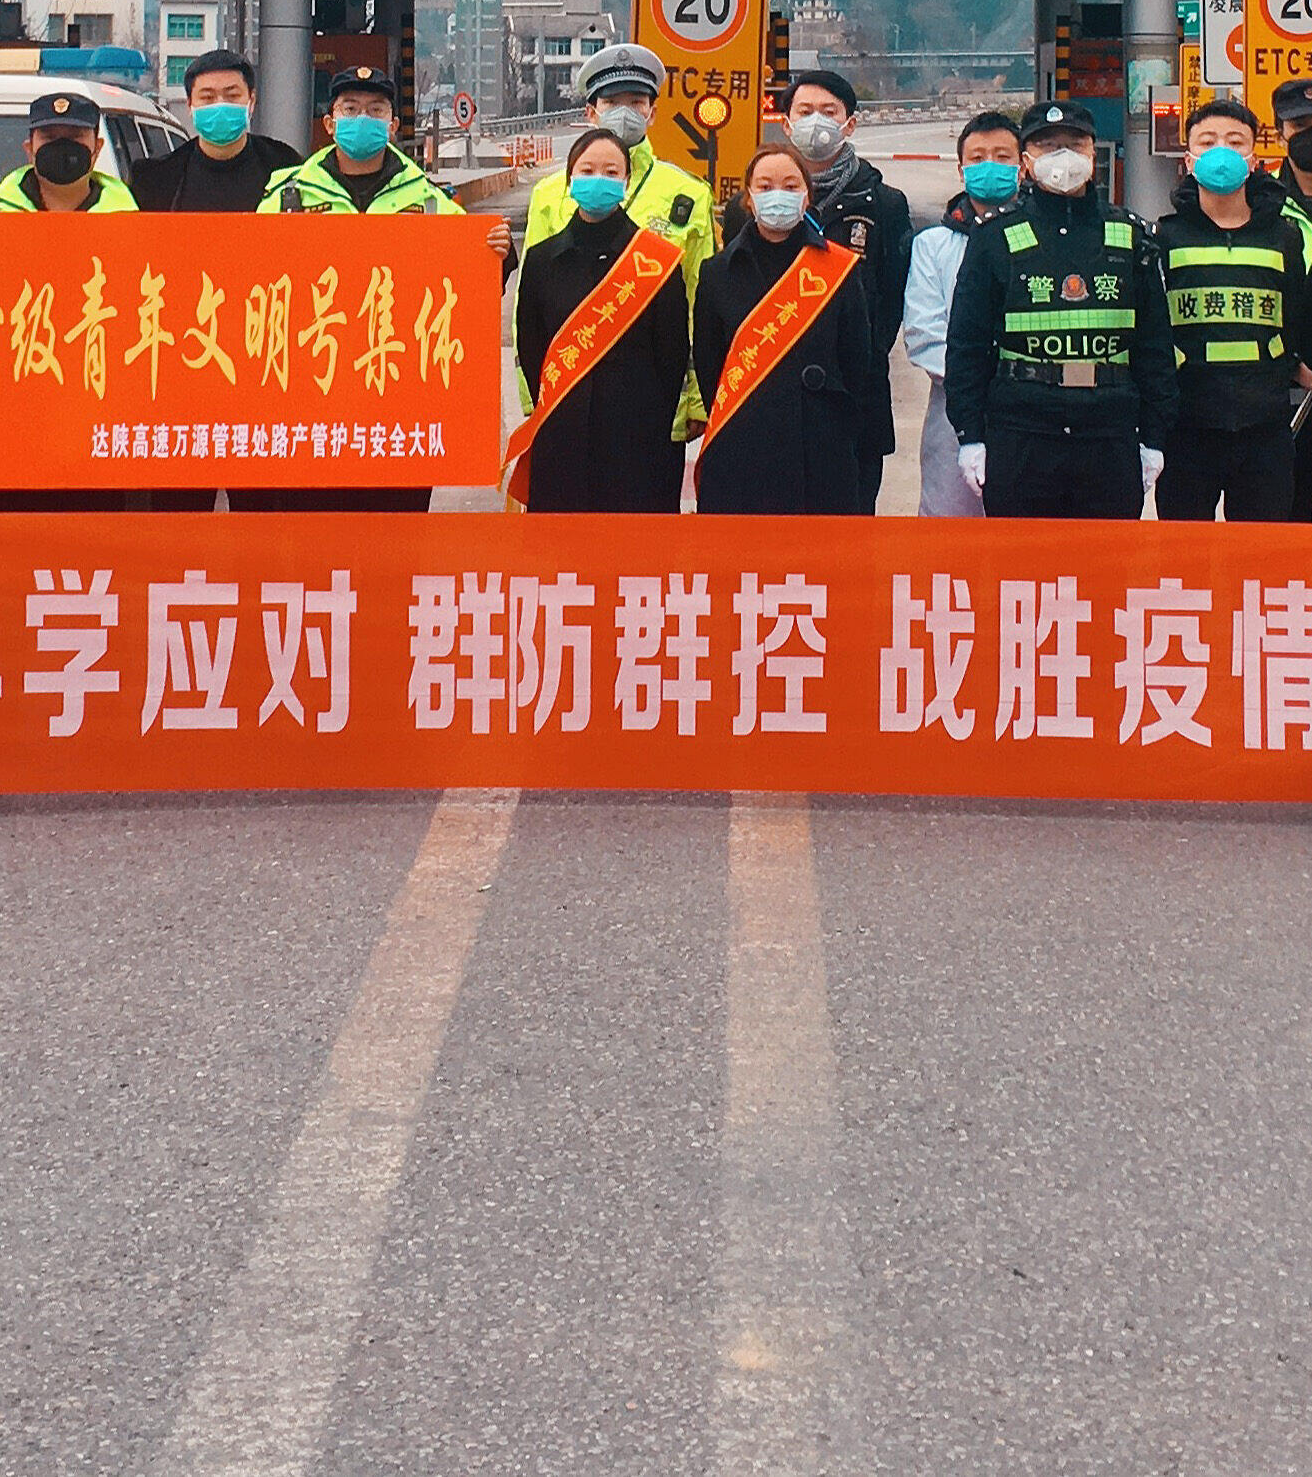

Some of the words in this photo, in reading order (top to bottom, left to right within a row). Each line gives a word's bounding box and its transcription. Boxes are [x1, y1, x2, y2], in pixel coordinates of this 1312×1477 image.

[665, 65, 751, 100] TC专用
[459, 101, 469, 119] 5
[1177, 290, 1277, 321] 收费稽查
[1026, 334, 1121, 356] POLICE
[407, 571, 829, 737] 群防群控
